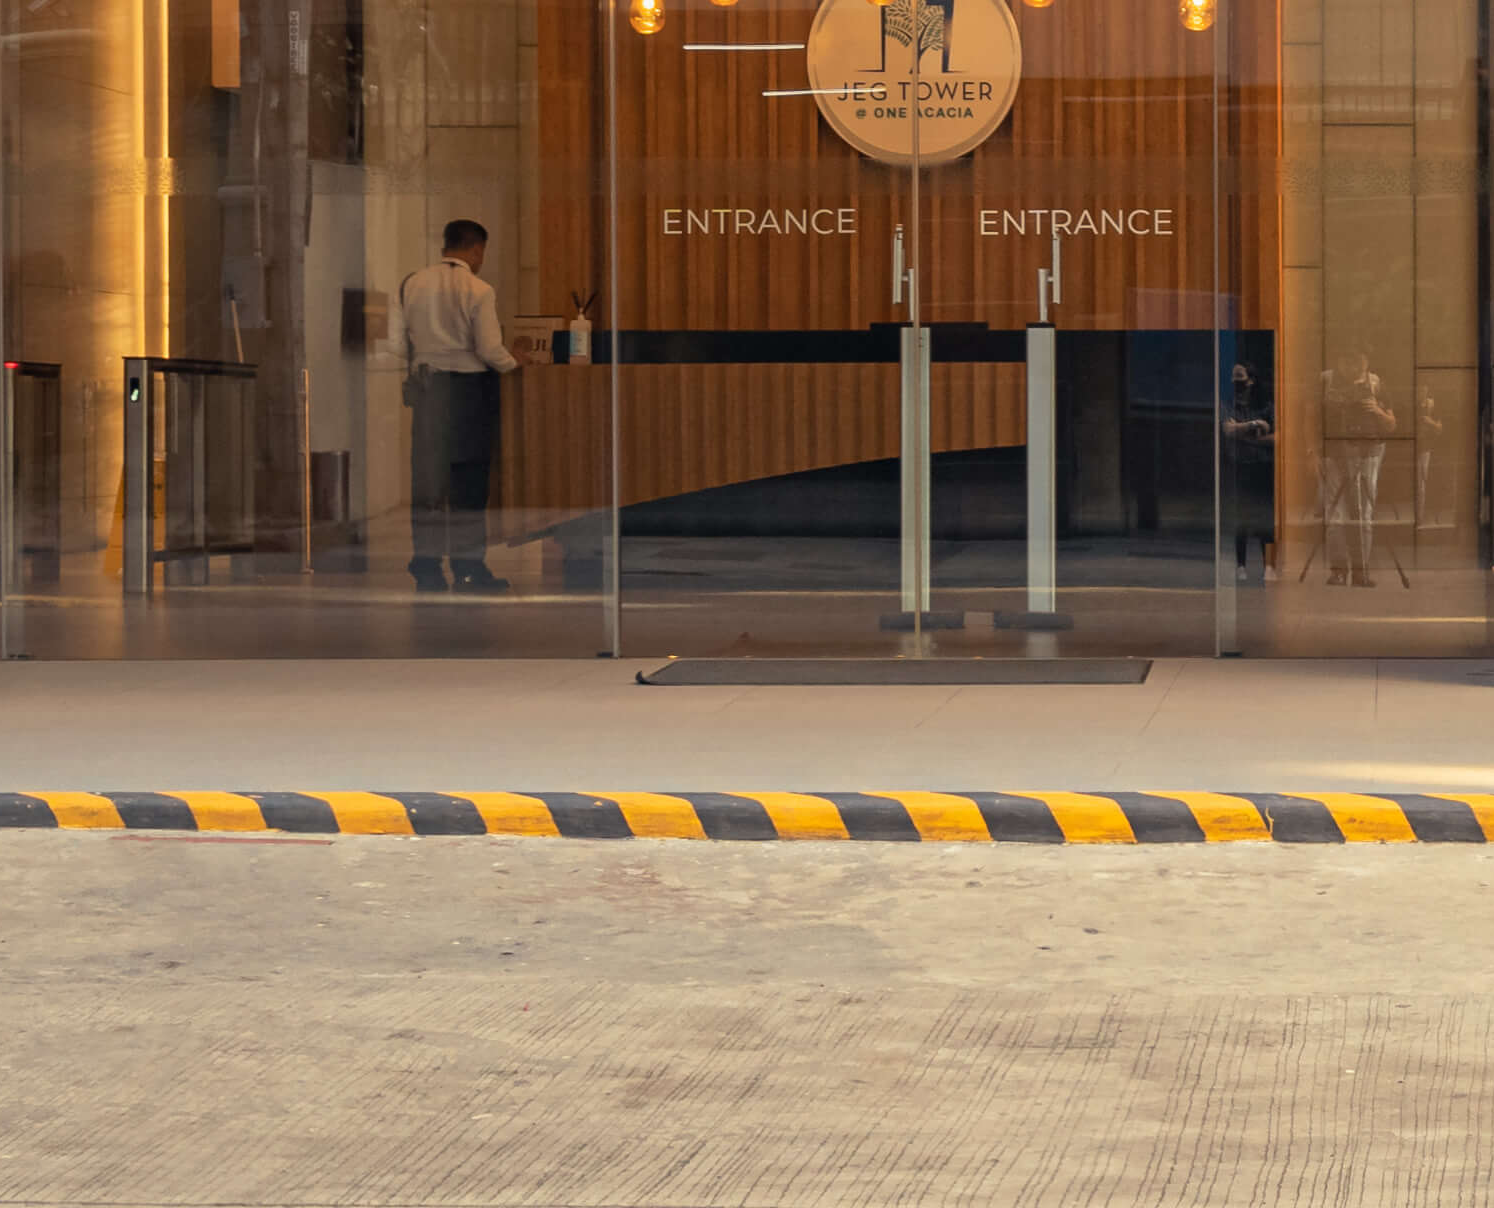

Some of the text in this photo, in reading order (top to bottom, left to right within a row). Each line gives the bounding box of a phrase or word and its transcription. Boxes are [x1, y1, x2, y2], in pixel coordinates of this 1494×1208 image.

[837, 81, 994, 102] JEG TOWER
[873, 106, 908, 119] ONE
[663, 208, 857, 235] ENTRANCE
[979, 209, 1174, 236] ENTRANCE
